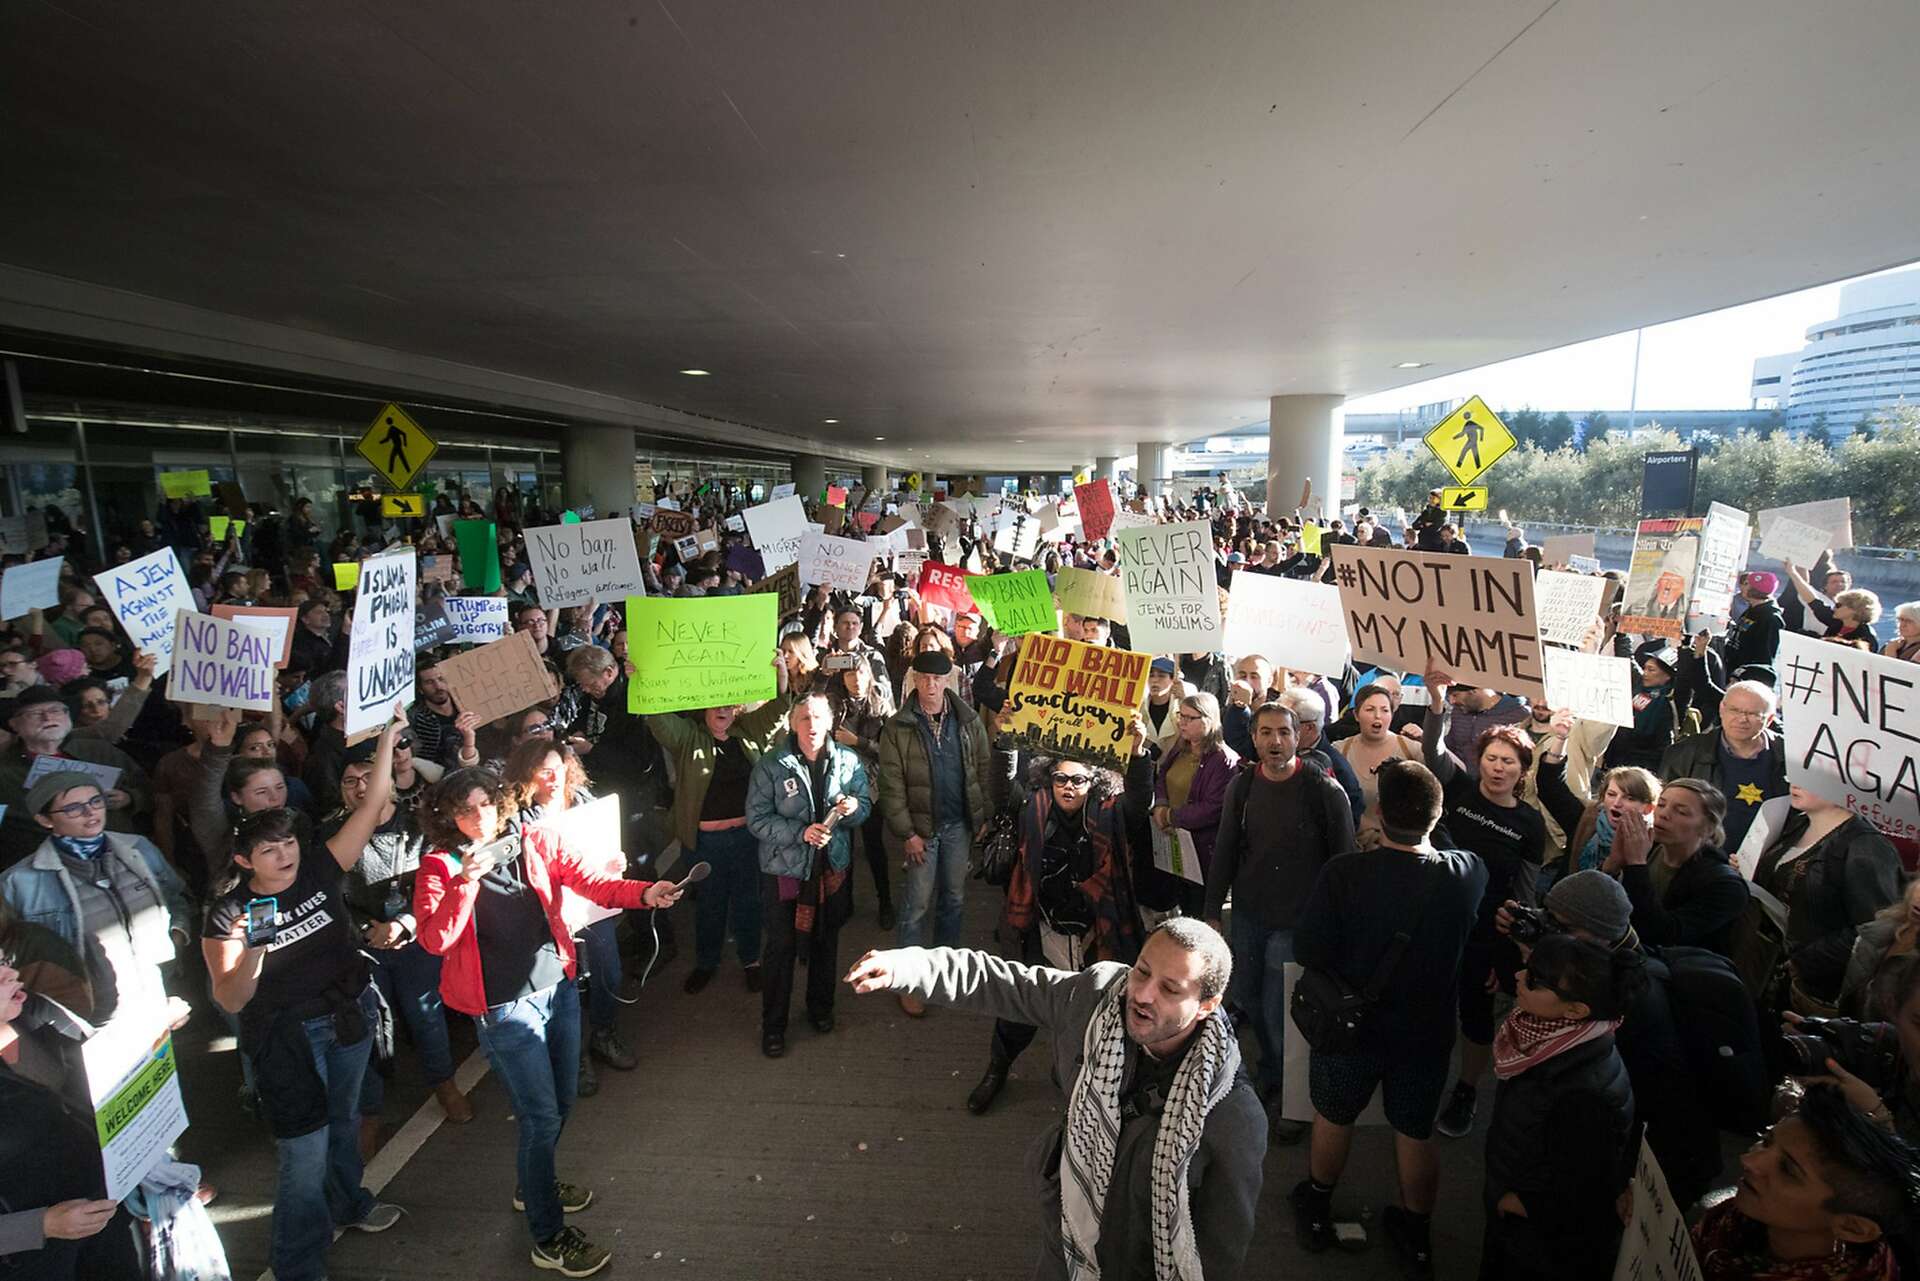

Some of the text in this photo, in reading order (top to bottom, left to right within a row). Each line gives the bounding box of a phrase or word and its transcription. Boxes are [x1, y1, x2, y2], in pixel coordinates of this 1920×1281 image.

[1647, 456, 1686, 464] Airporters
[536, 527, 617, 563] No ban.
[817, 543, 845, 557] NO
[1122, 530, 1209, 566] NEVER
[115, 554, 175, 598] A JEW
[544, 555, 616, 586] No wall.
[812, 559, 863, 574] ORANGE
[812, 569, 858, 586] FEVER
[929, 569, 966, 592] RES
[1128, 566, 1203, 595] AGAIN
[120, 584, 175, 621] AGAINST
[1337, 559, 1450, 607] #NOT
[1470, 568, 1525, 617] IN
[141, 607, 168, 628] THE
[370, 592, 409, 623] PHOBIA
[461, 612, 479, 622] UP
[1138, 602, 1208, 618] JEWS FOR
[140, 623, 174, 646] MUS
[386, 623, 398, 649] IS
[416, 617, 447, 634] SLIM
[657, 620, 742, 642] NEVER
[1155, 616, 1215, 631] MUSLIMS
[184, 617, 271, 668] NO BAN
[672, 641, 757, 665] AGAIN!
[1027, 636, 1146, 680] NO BAN
[1351, 611, 1543, 683] MY NAME
[181, 660, 271, 699] NO WALL
[1019, 662, 1138, 707] NO WALL
[1785, 655, 1920, 743] #NE
[1047, 714, 1083, 726] for all
[1803, 723, 1920, 815] AGA
[1456, 806, 1522, 840] #NotMyPresident
[1846, 794, 1920, 840] Refuge
[295, 891, 327, 917] LIVES
[273, 915, 326, 947] MATTER
[105, 1081, 152, 1133] WELCOME
